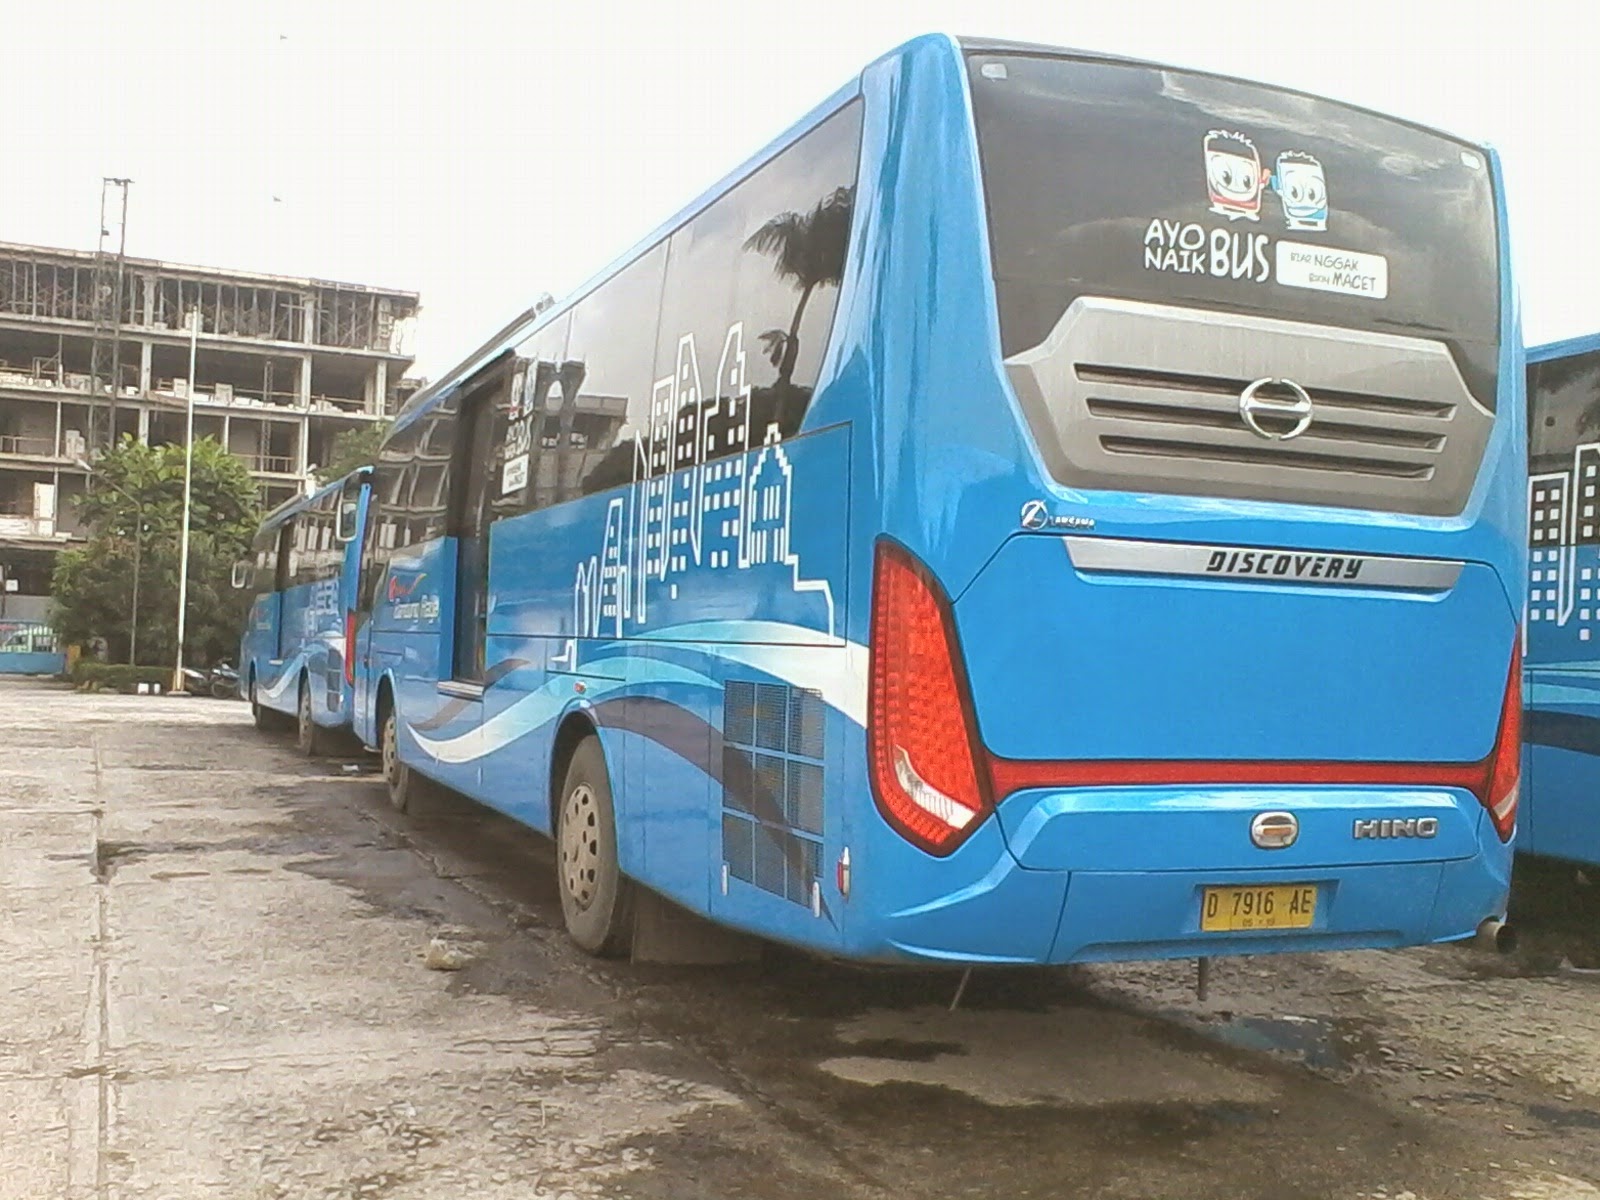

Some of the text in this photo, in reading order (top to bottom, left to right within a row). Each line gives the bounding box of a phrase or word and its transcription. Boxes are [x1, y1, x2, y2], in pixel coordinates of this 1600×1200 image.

[1144, 219, 1205, 250] AYO
[1145, 246, 1206, 274] NAIK
[1210, 228, 1270, 283] BUS
[1314, 254, 1359, 271] NGGAK
[1332, 271, 1377, 291] MACET
[1206, 551, 1364, 579] DISCOVERY
[1354, 817, 1438, 839] HINO
[1207, 889, 1313, 918] D 7916 AE
